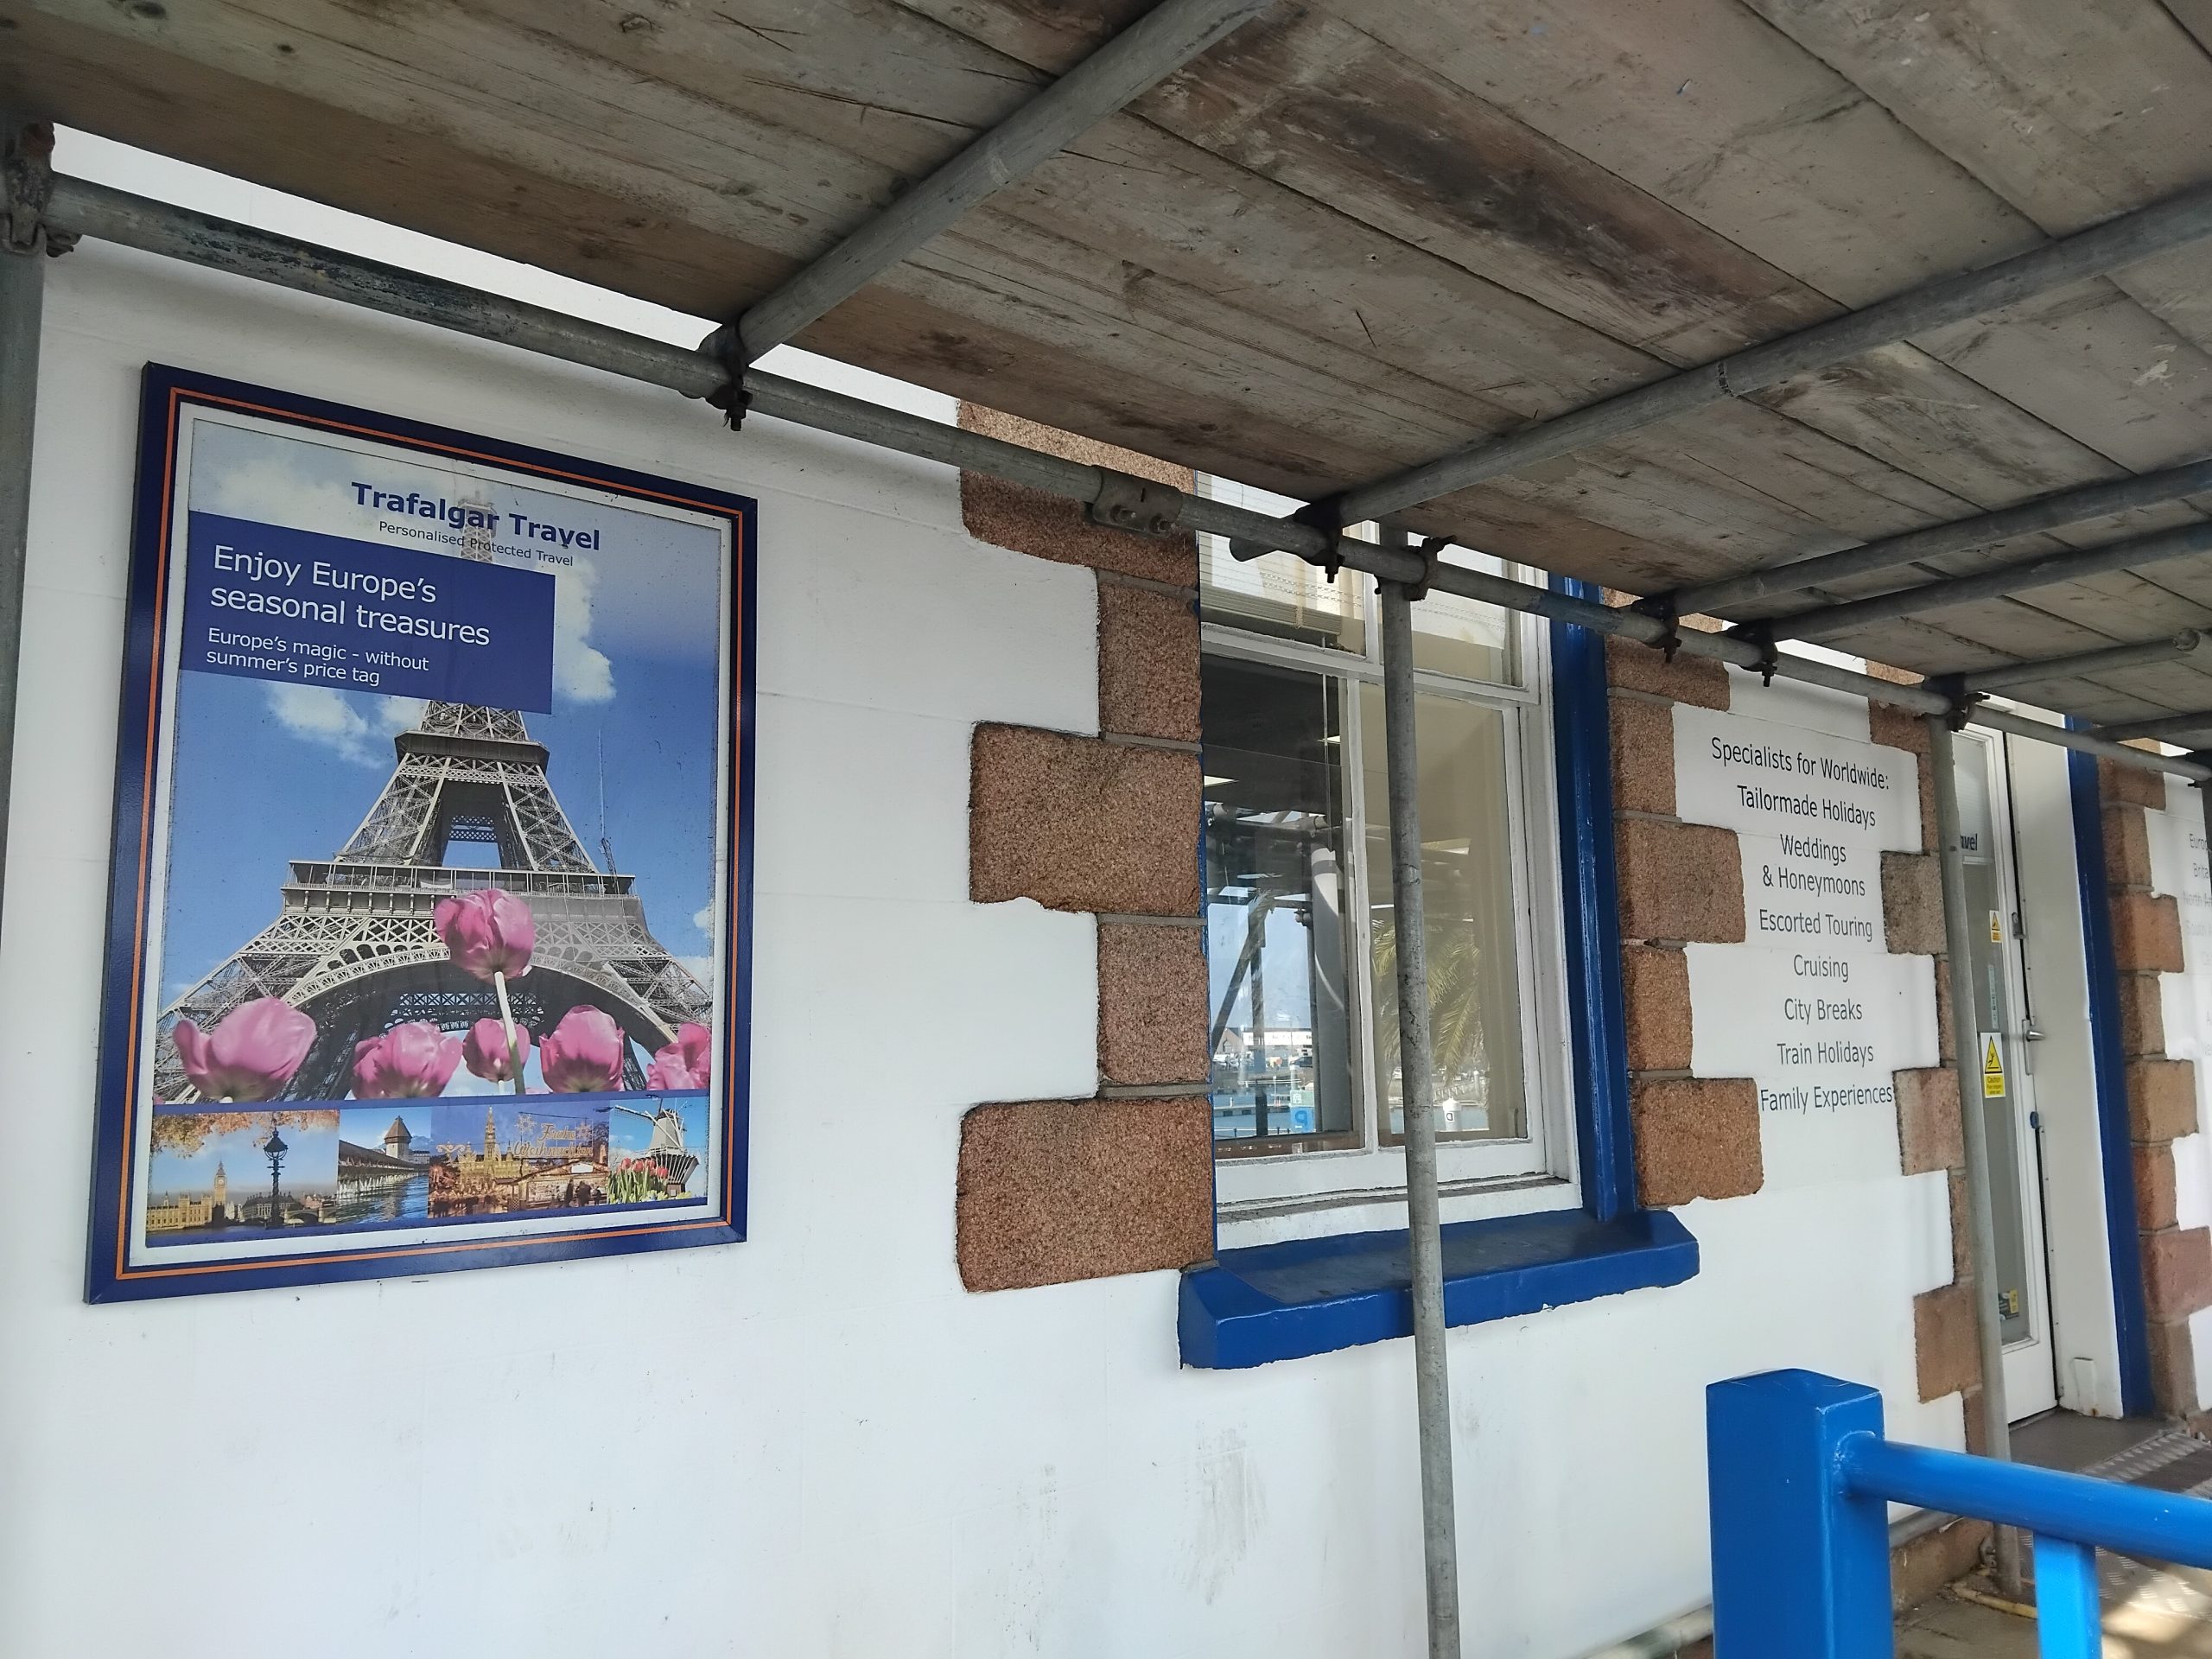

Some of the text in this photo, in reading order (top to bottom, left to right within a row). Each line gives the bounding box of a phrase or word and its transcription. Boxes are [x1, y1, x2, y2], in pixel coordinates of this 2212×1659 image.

[352, 481, 600, 550] Trafalgar Travel
[379, 520, 573, 566] Personalised Protected Travel
[214, 544, 436, 603] Enjoy Europe's
[210, 586, 490, 645] seasonal treasures
[208, 628, 287, 652] Europe's
[293, 641, 346, 661] magic
[365, 651, 429, 671] without
[207, 651, 379, 687] summer's price tag
[1711, 736, 1890, 790] Specialists for Worldwide:
[1737, 785, 1876, 830] Tailormade Holidays
[1780, 834, 1847, 866] Weddings
[1763, 864, 1866, 898] & Honeymoons
[1759, 909, 1872, 942] Escorted Touring
[1793, 954, 1849, 982] Cruising
[1784, 998, 1863, 1025] City Breaks
[1777, 1040, 1874, 1068] Train Holidays
[1760, 1084, 1893, 1115] Family Experiences
